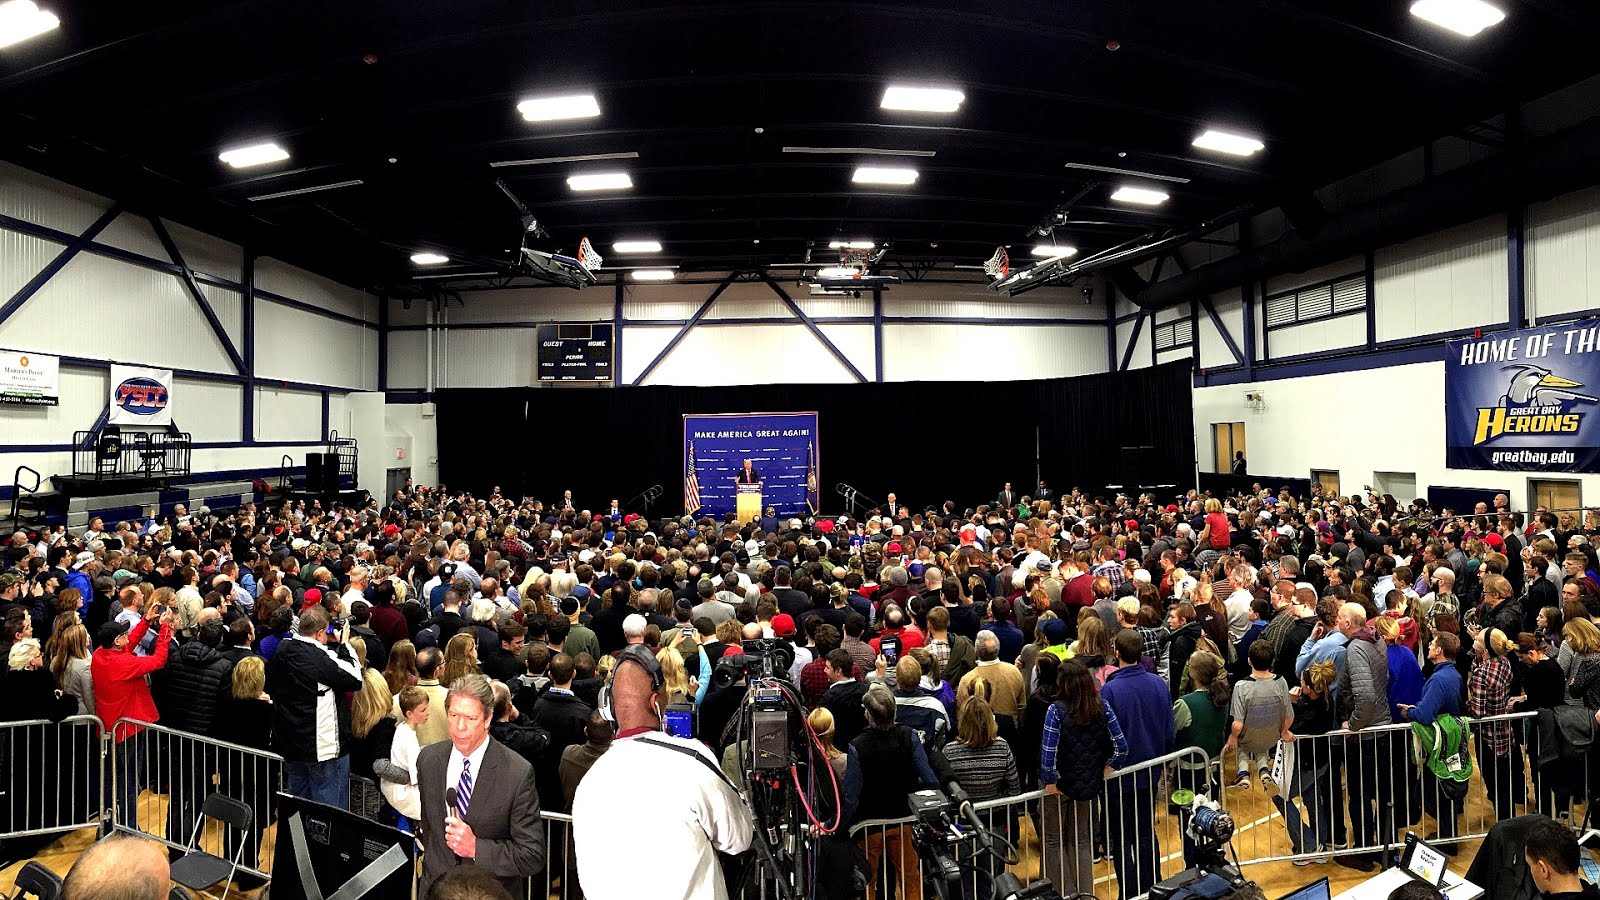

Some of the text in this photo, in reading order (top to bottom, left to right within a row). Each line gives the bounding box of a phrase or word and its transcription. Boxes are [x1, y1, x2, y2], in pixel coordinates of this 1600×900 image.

[1461, 337, 1521, 366] HOME
[1525, 332, 1557, 359] OF
[1510, 405, 1562, 416] GREAT BAY
[1474, 407, 1580, 446] HERONS
[694, 431, 715, 439] MAKE
[717, 430, 753, 438] AMERICA
[1492, 450, 1575, 465] greatbay.edu
